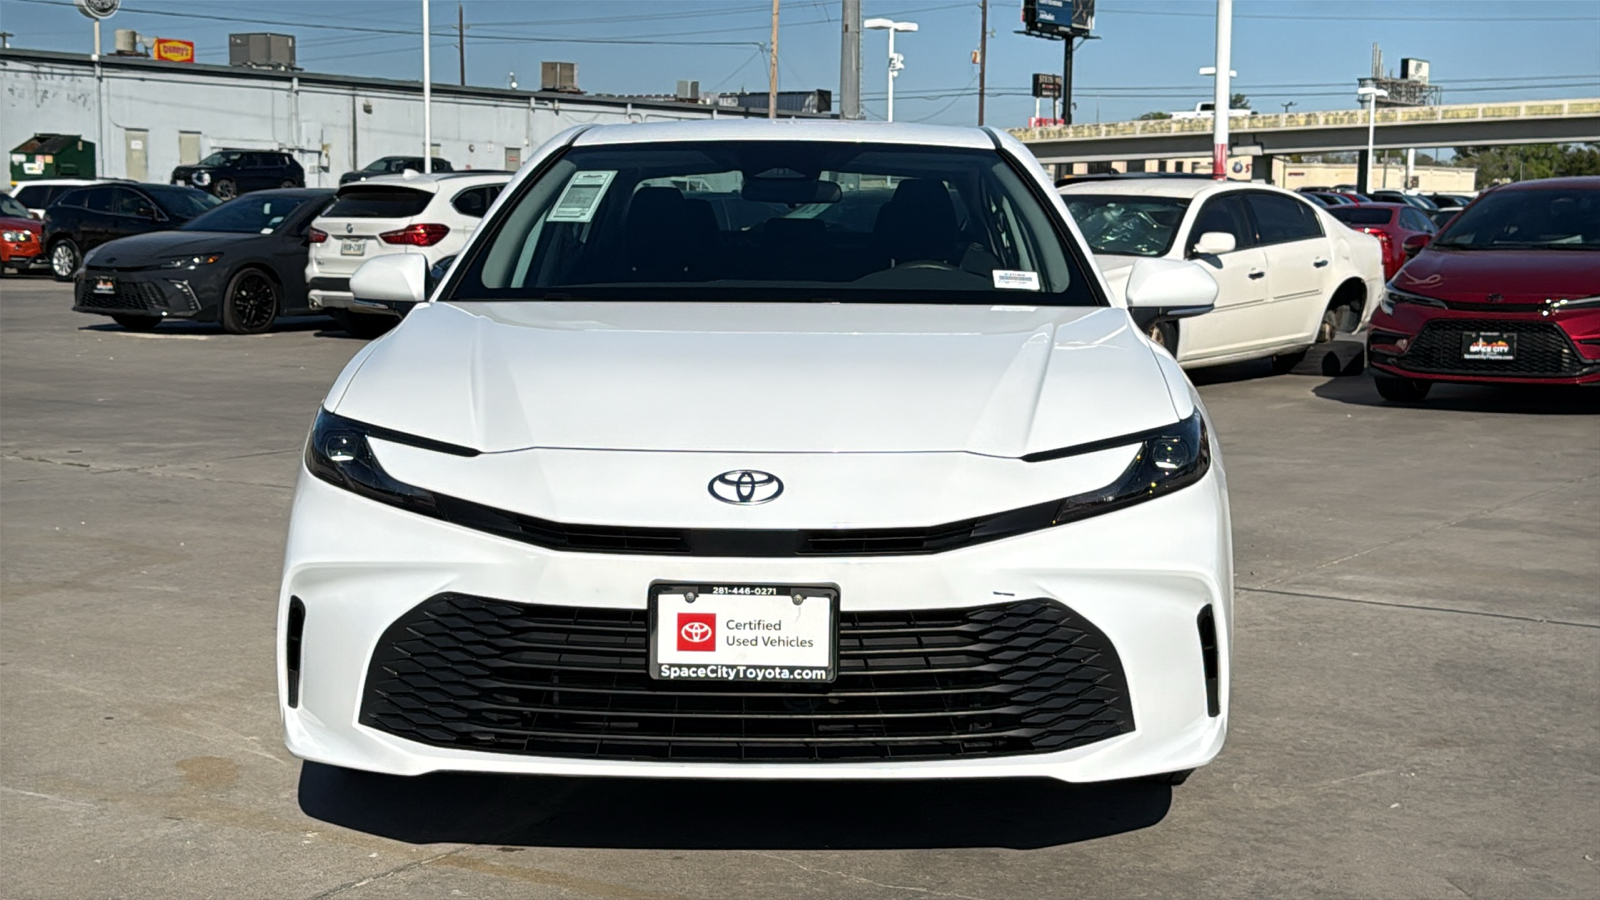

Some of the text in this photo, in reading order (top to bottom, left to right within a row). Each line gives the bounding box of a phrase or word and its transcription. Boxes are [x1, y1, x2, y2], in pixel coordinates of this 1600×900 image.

[1469, 344, 1509, 353] SPACE CITY
[712, 586, 777, 596] 281-446-0271
[726, 619, 782, 631] Certified
[726, 635, 814, 648] Used Vehicles
[660, 664, 826, 681] SpaceCityToyota.com
